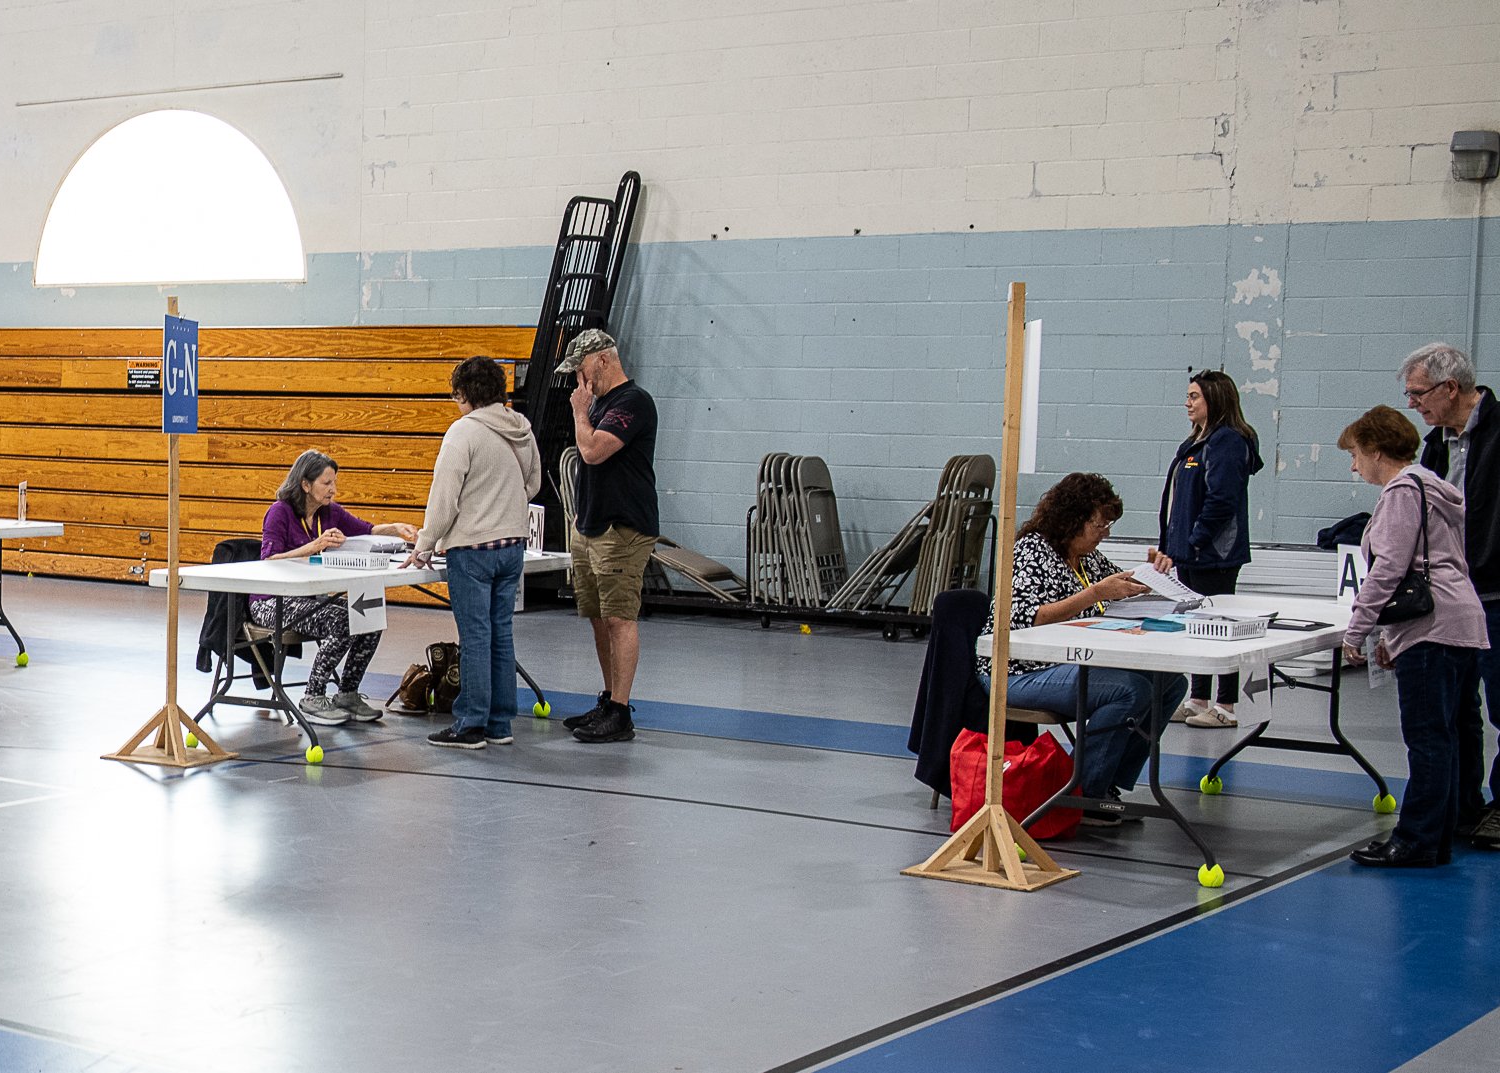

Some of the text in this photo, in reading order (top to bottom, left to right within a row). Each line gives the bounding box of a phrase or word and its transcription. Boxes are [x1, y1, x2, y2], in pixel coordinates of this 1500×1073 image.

[166, 339, 196, 397] G-N
[529, 510, 543, 550] G-N
[1067, 647, 1094, 661] LRD
